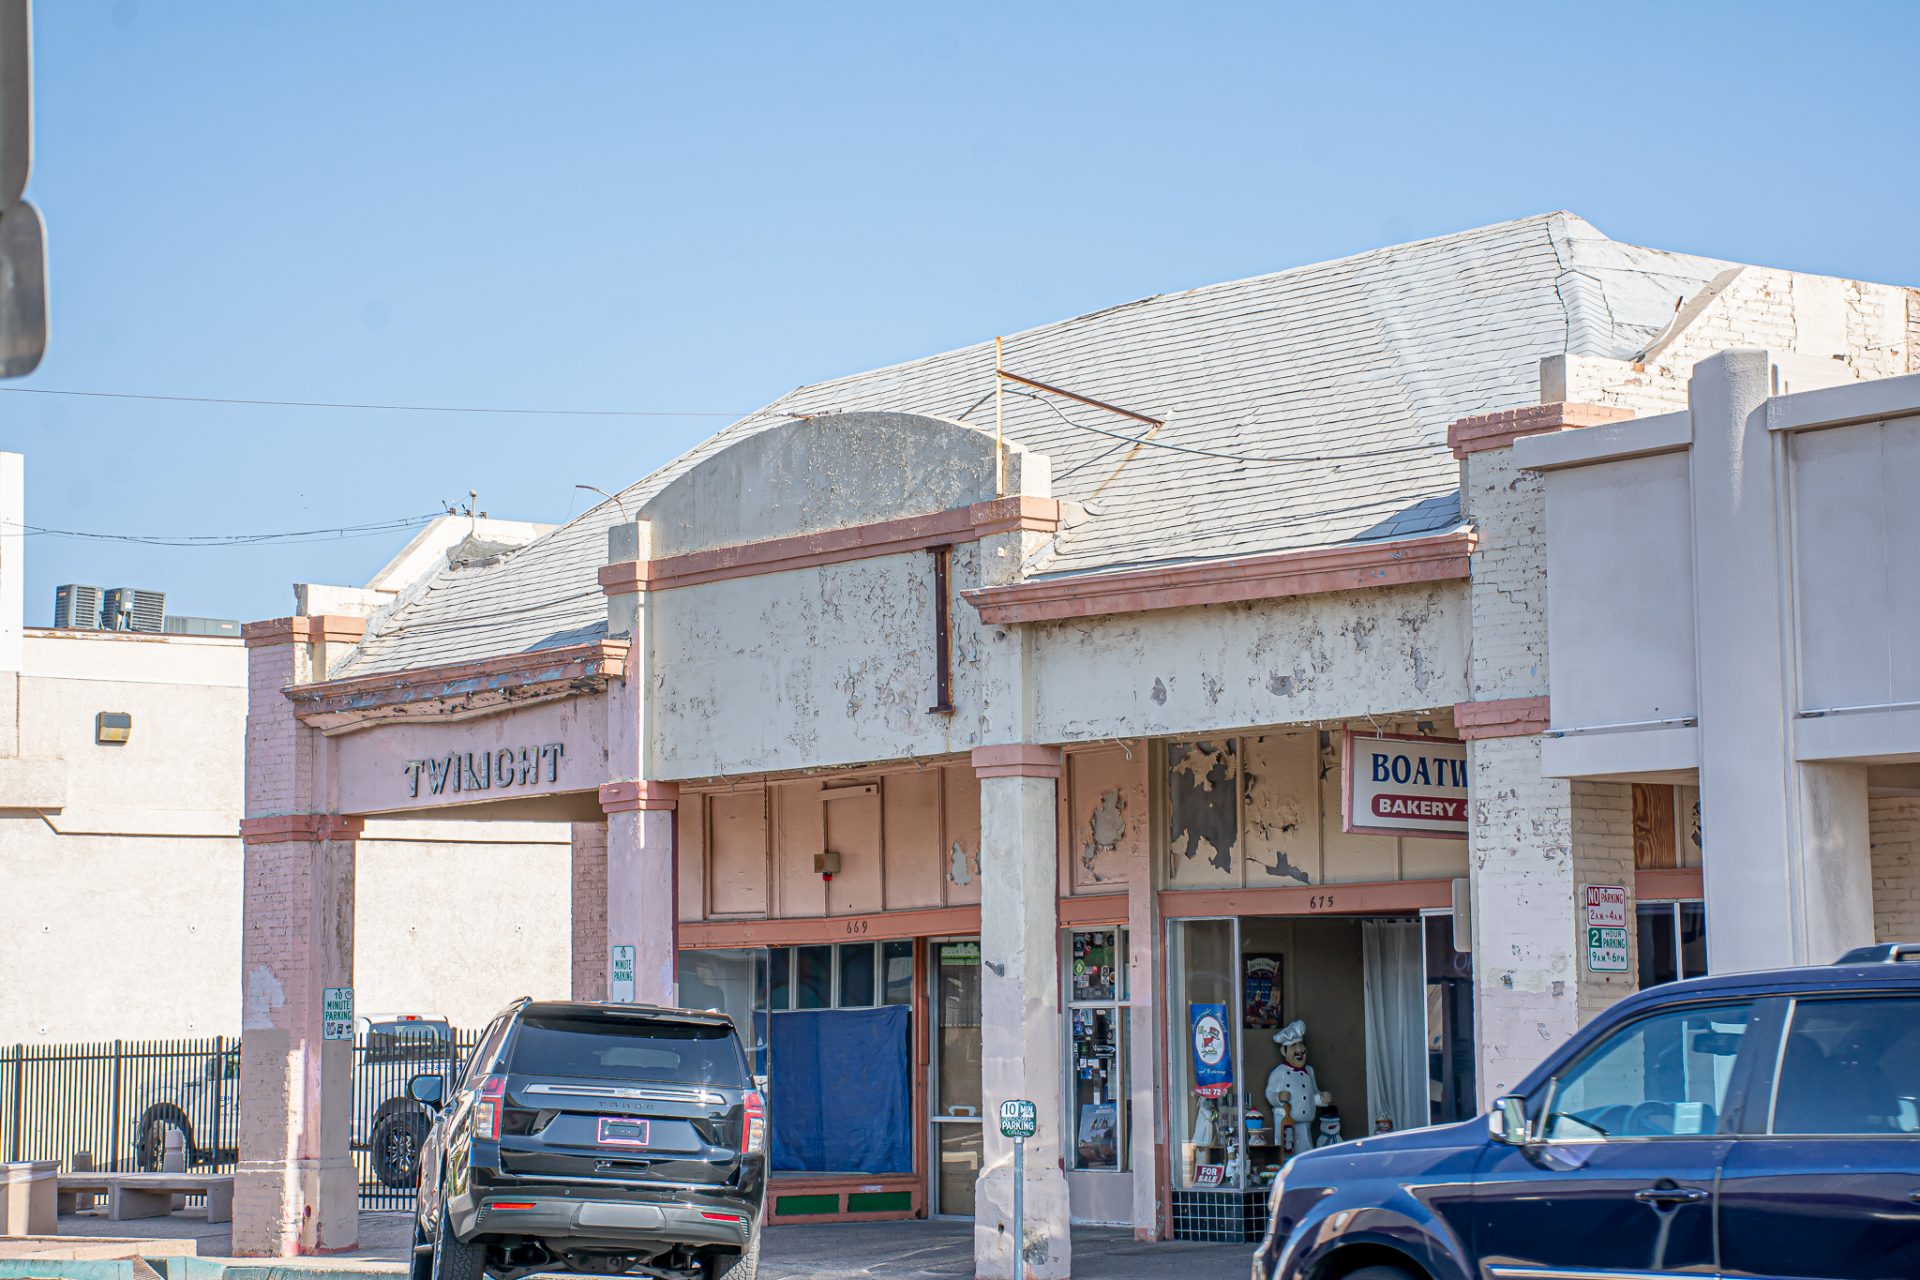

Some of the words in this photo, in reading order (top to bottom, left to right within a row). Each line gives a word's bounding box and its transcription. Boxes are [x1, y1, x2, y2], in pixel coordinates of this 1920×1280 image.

[404, 743, 564, 798] TWILIGHT
[1379, 798, 1457, 817] BAKERY
[1310, 895, 1334, 909] 675
[1588, 888, 1600, 905] NO
[1601, 893, 1624, 904] PARKING
[847, 920, 868, 934] 669
[1591, 930, 1600, 946] 2
[1605, 930, 1622, 938] HOUR
[1603, 938, 1625, 949] PARKING
[334, 991, 343, 1000] 10
[327, 1000, 351, 1011] MINUTE
[325, 1010, 352, 1021] PARKING
[598, 1101, 656, 1110] TAHOE
[1005, 1103, 1016, 1116] 10
[1002, 1121, 1034, 1131] PARKING
[1201, 1167, 1218, 1176] FOR
[1197, 1175, 1218, 1183] SALE
